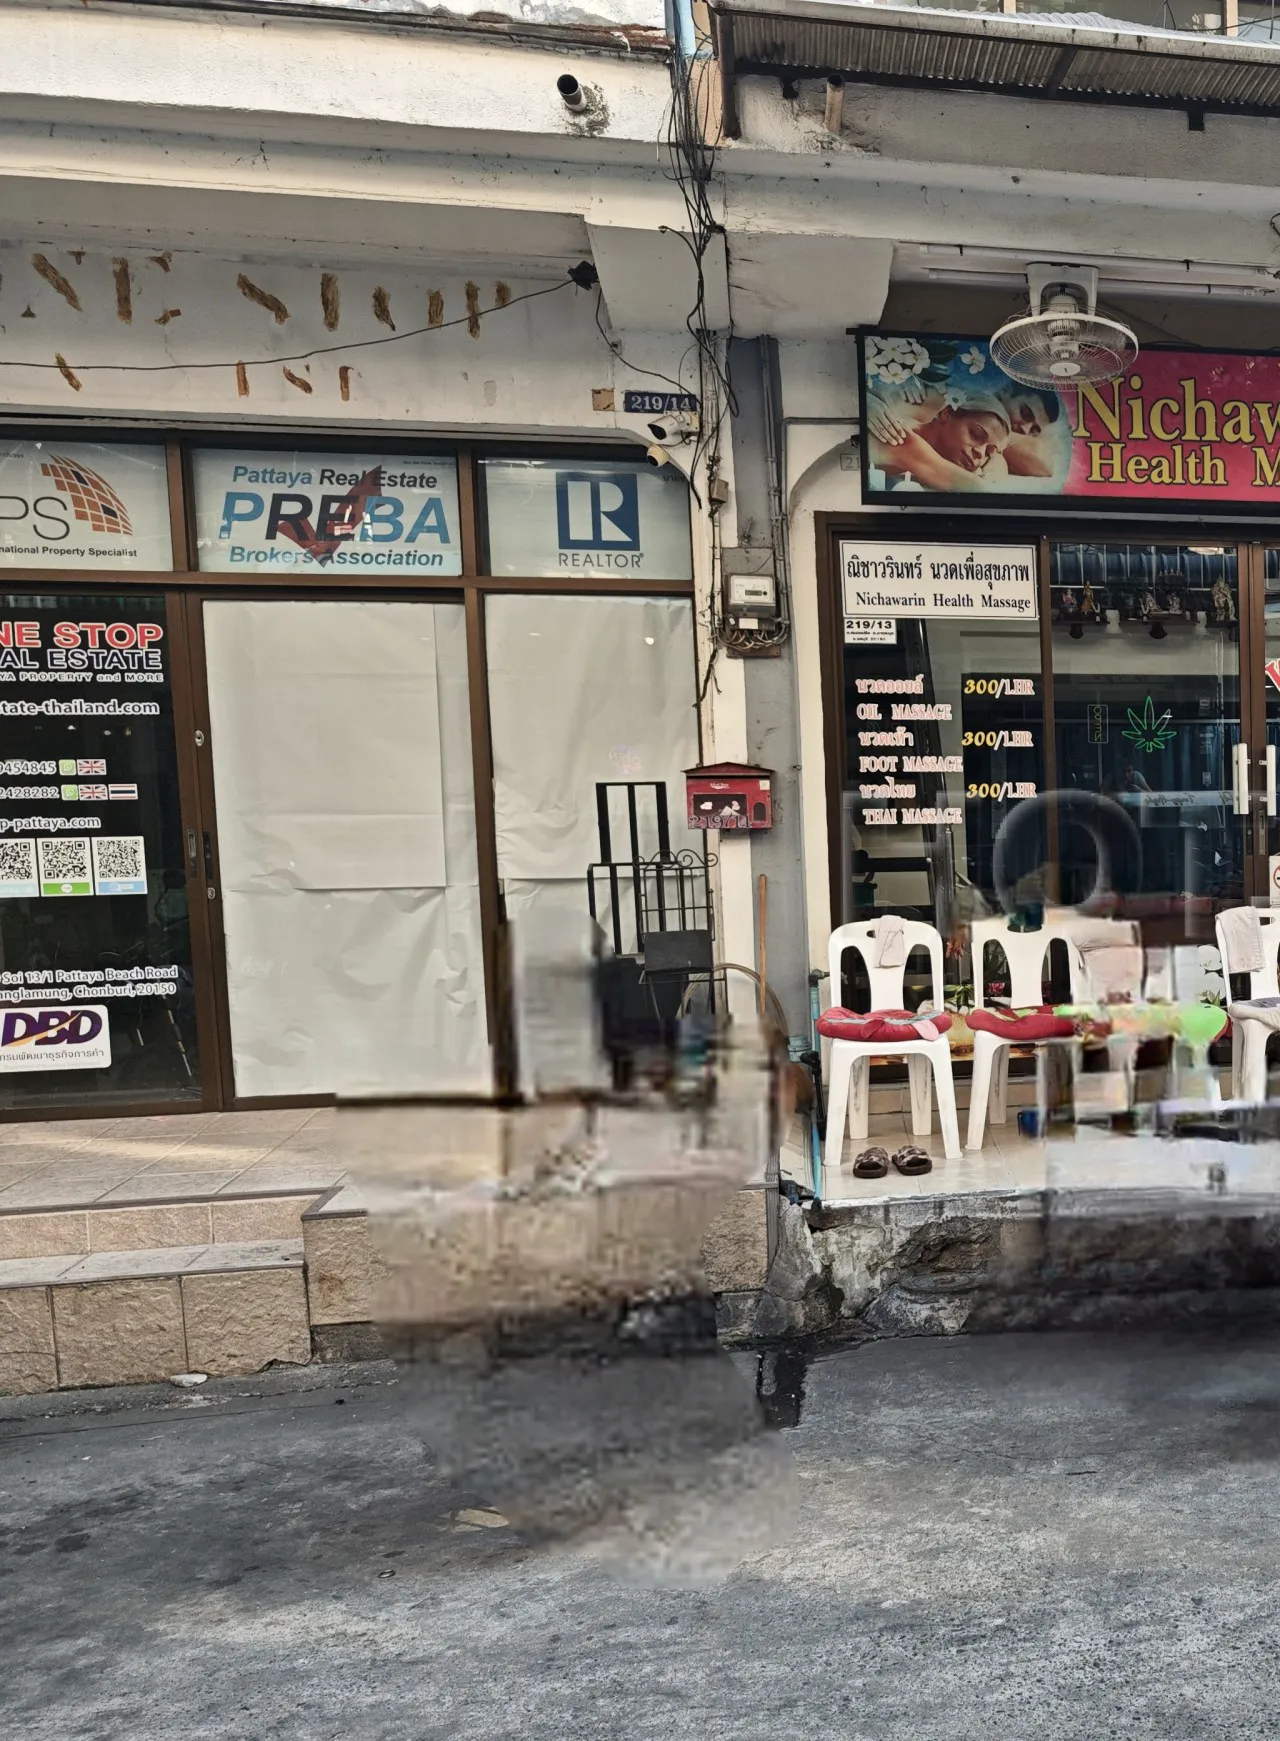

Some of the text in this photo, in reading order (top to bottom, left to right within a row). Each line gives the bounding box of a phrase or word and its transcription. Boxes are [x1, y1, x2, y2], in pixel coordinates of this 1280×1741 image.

[631, 394, 691, 411] 219/14
[1086, 441, 1228, 486] Health
[232, 465, 438, 489] Pattaya Real Estate
[218, 491, 451, 545] PREBA
[42, 546, 86, 557] Property
[88, 547, 138, 557] Specialist
[229, 545, 444, 566] Brokers Association
[847, 551, 1030, 590] ณิชาวรินทร์ นวดเพื่อสุขภาพ
[855, 591, 1032, 613] Nichawarin Health Massage
[846, 620, 892, 630] 219/13
[53, 622, 163, 649] STOP
[47, 649, 162, 669] ESTATE
[19, 672, 93, 683] PROPERTY
[96, 672, 121, 683] and
[125, 673, 164, 683] MORE
[855, 674, 924, 694] นวดออยล์
[856, 704, 952, 720] OIL MASSAGE
[858, 726, 914, 747] นวดเท้า
[859, 756, 963, 773] FOOT MASSAGE
[859, 775, 916, 798] นวดไทย
[862, 808, 963, 824] THAI MASSAGE
[2, 965, 179, 985] Soi 13/1 Pattaya Beach Road
[73, 984, 136, 1000] Chonburi,
[136, 982, 177, 996] 20150
[1, 1009, 103, 1047] DBD
[0, 1049, 104, 1063] กรมพัฒนาธุรกิจการค้า
